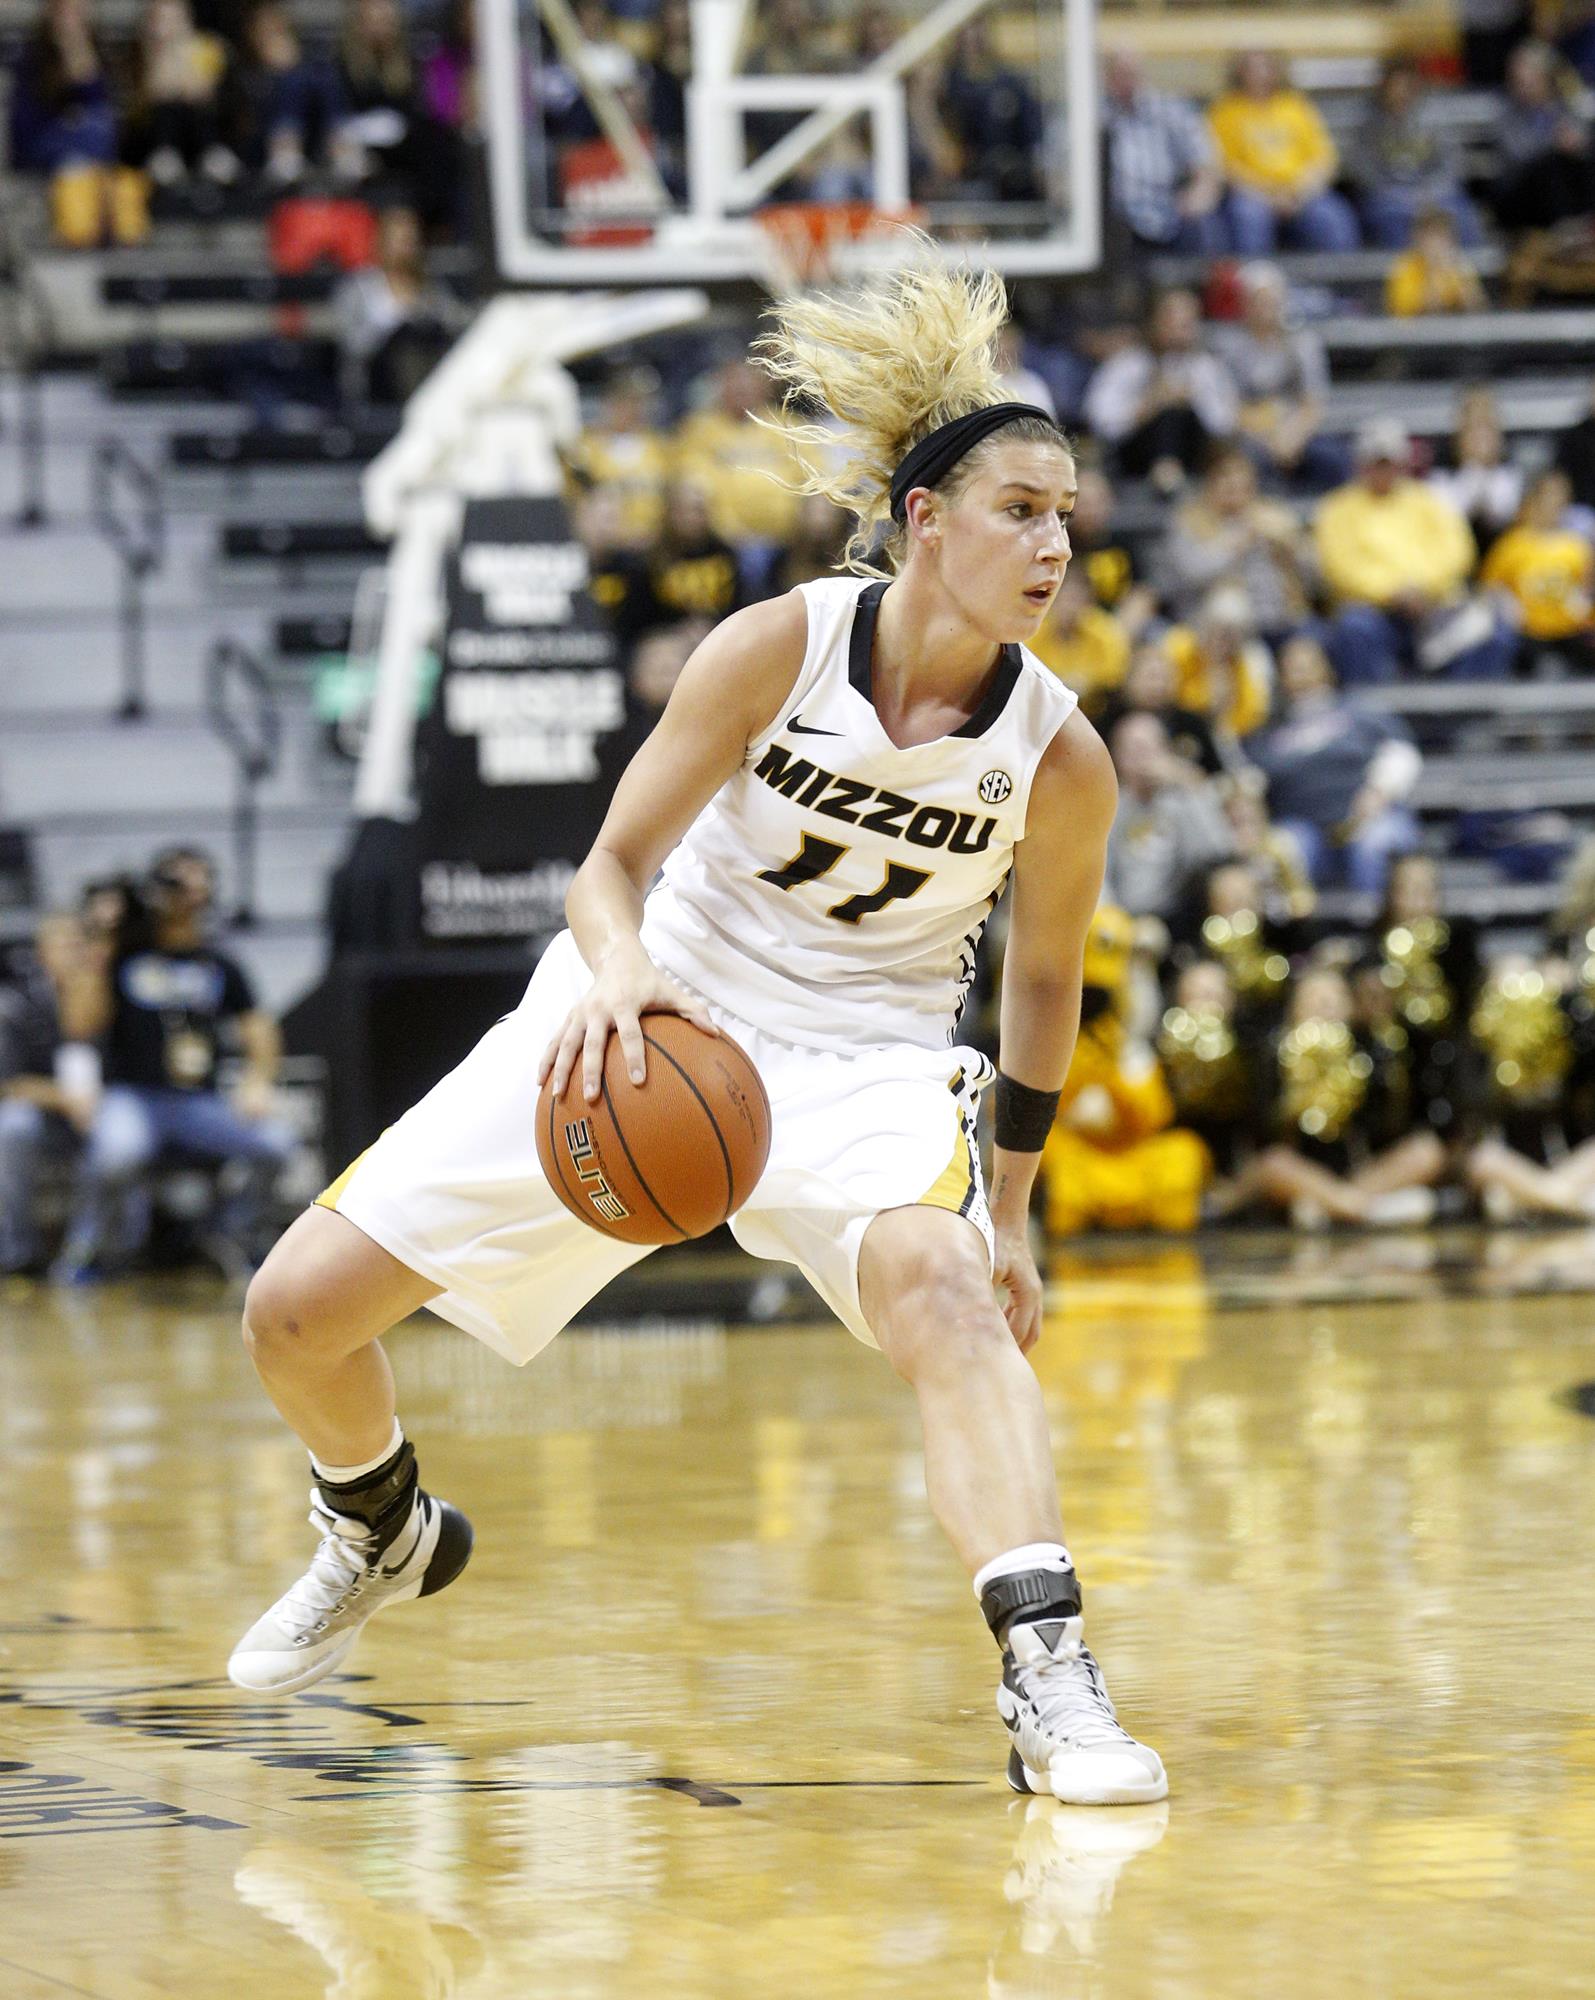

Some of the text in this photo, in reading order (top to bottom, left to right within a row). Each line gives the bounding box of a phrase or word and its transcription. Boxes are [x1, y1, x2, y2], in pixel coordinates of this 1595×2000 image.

[754, 743, 999, 854] MIZZOU
[979, 770, 1012, 803] SEC
[753, 829, 936, 926] 11
[565, 1117, 630, 1222] ELITE
